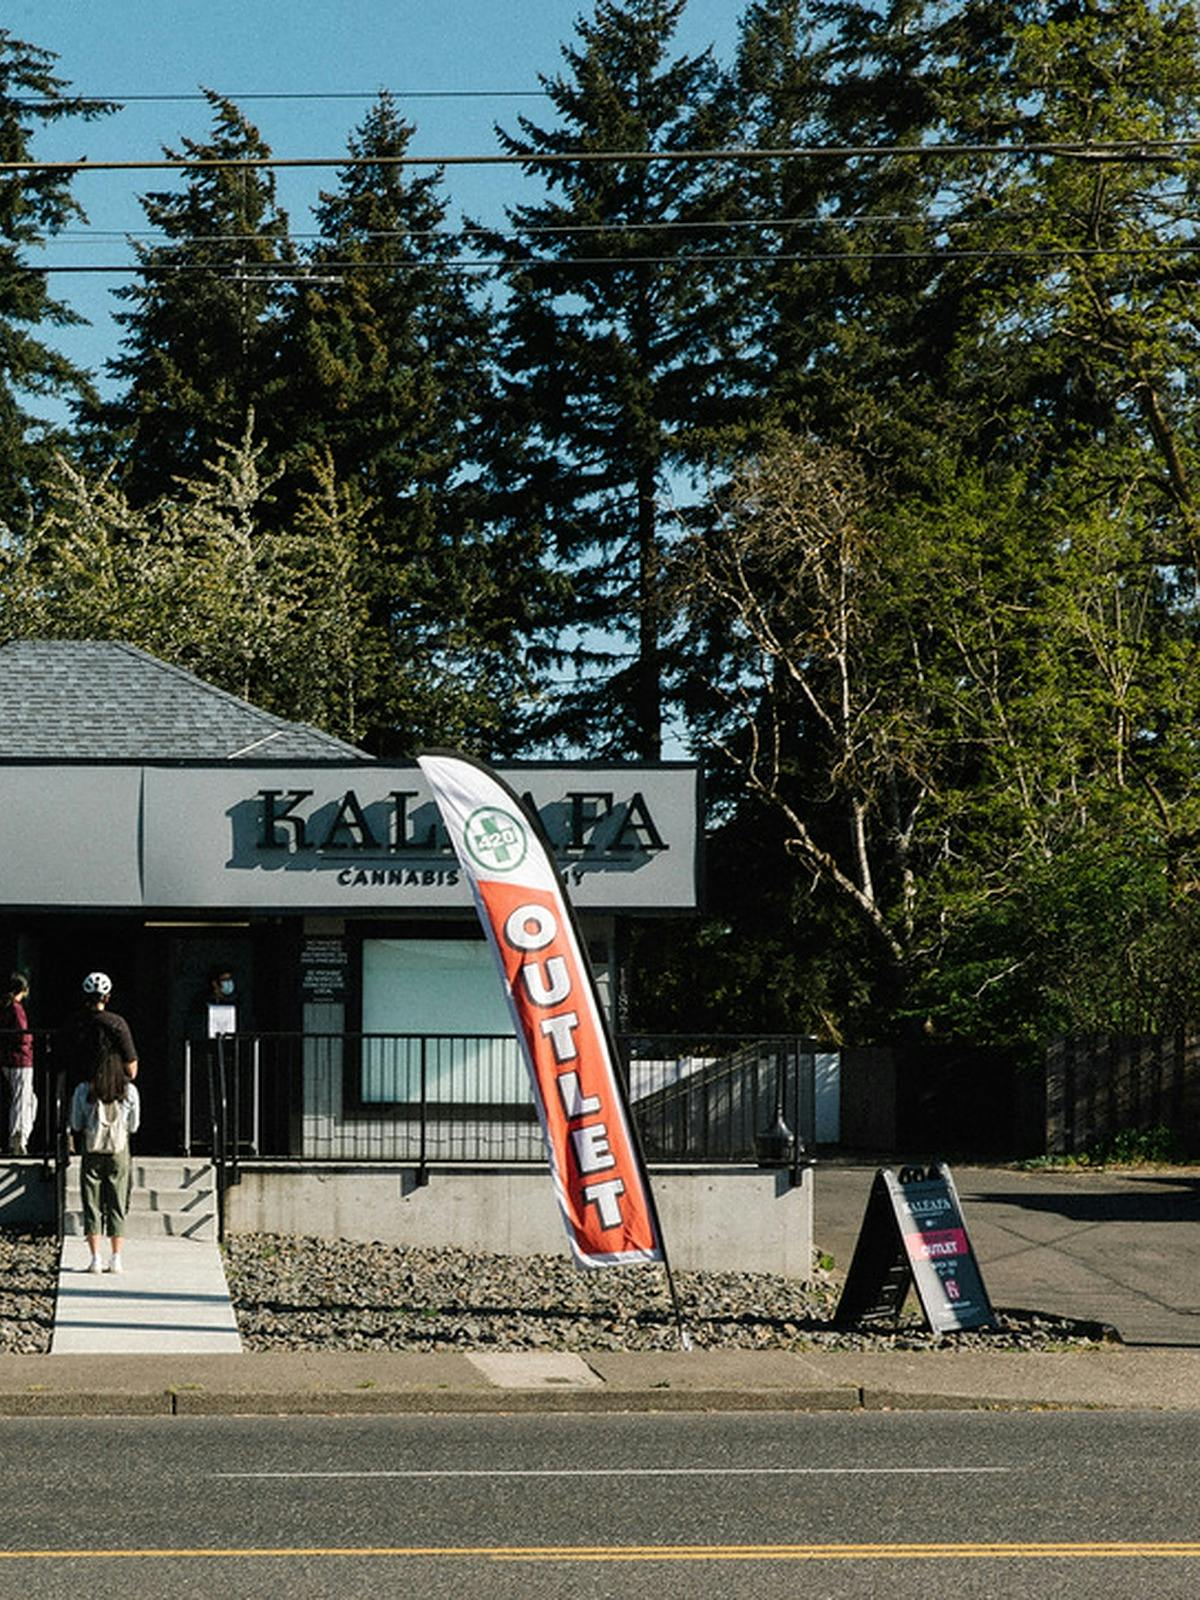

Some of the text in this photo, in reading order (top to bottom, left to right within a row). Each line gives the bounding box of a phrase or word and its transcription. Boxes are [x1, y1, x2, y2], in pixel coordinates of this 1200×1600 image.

[477, 828, 516, 850] 420
[337, 870, 459, 886] CANNABIS
[505, 903, 625, 1229] OUTLET
